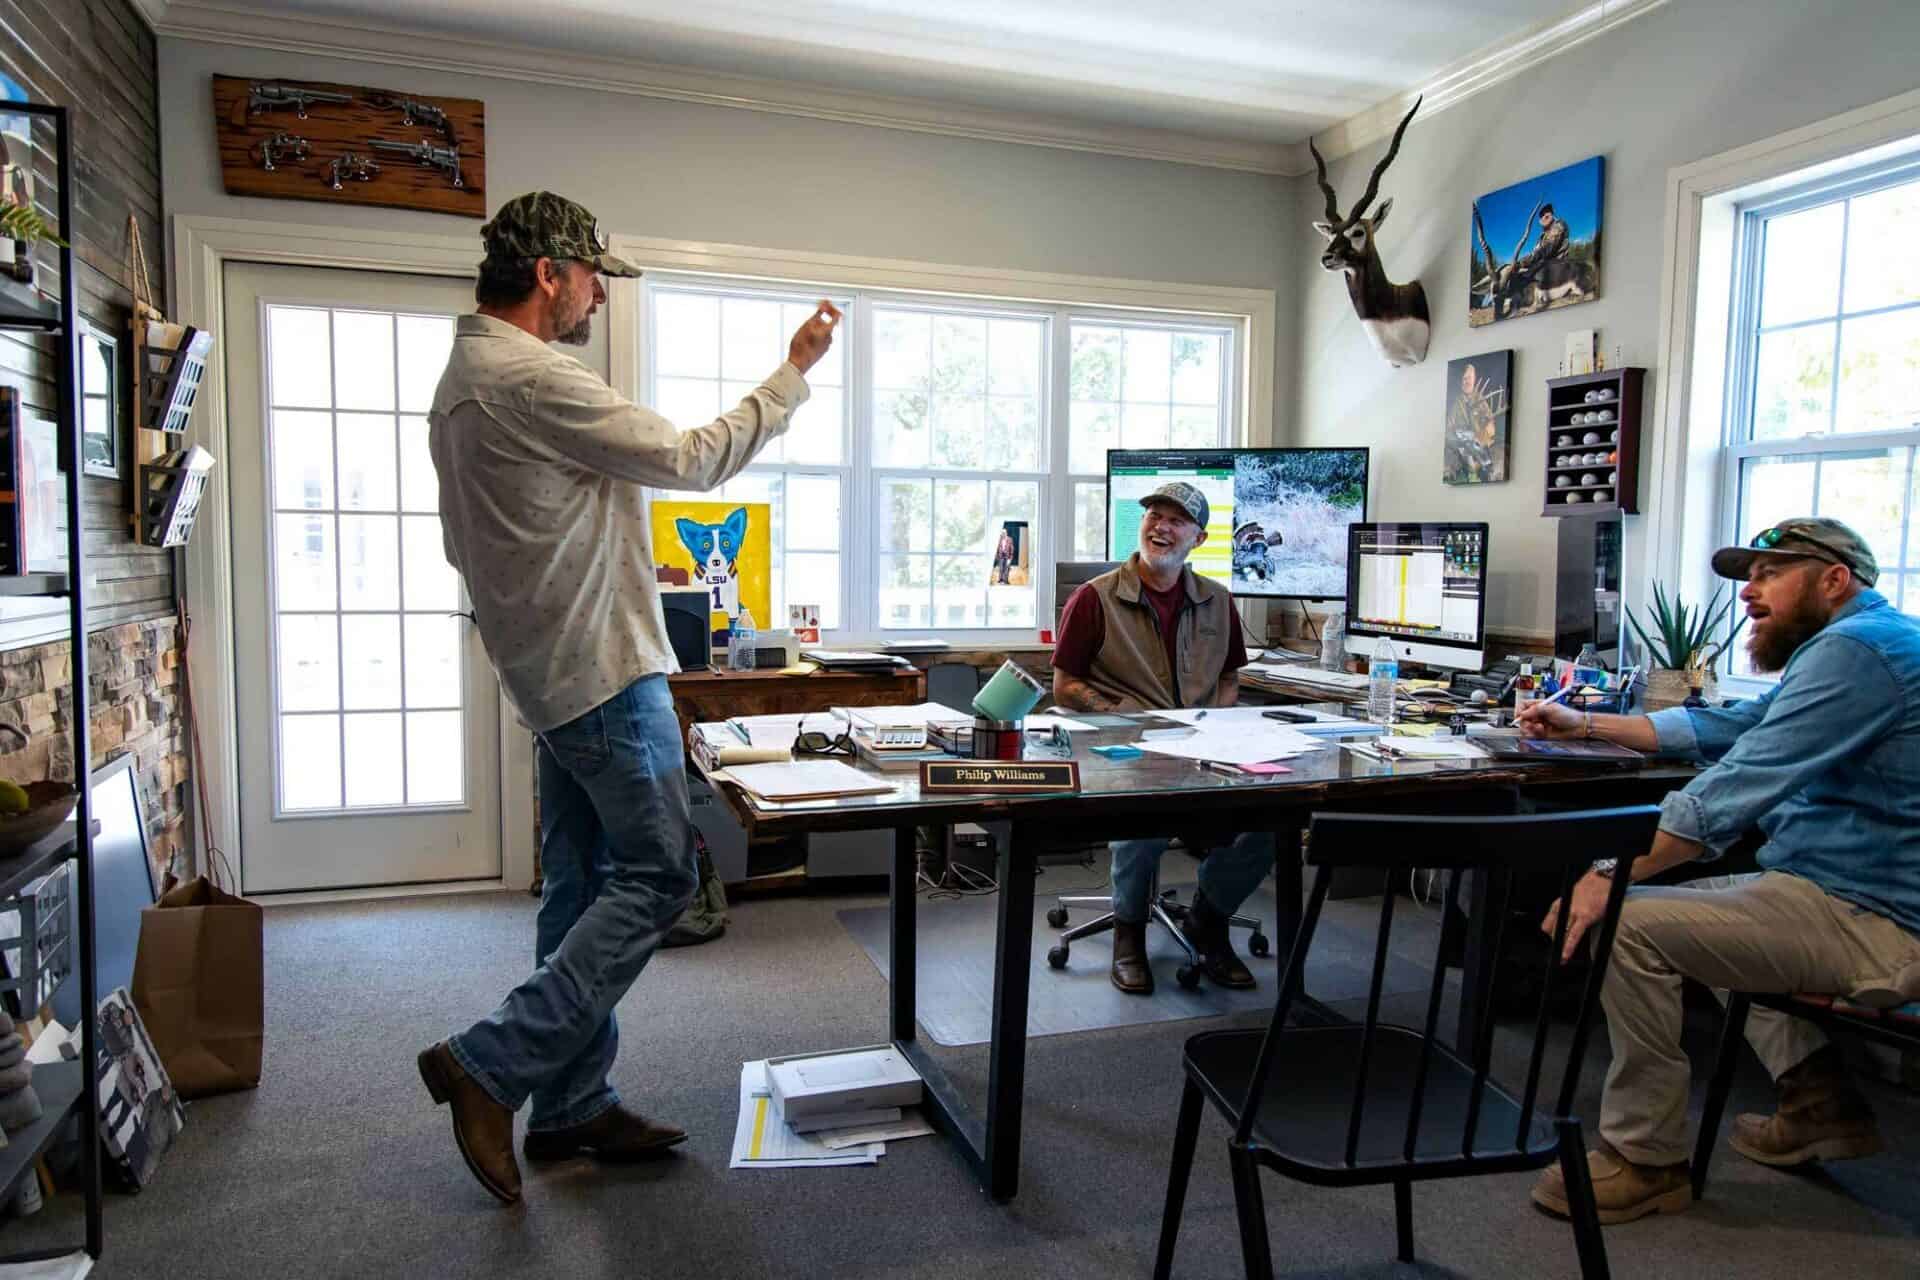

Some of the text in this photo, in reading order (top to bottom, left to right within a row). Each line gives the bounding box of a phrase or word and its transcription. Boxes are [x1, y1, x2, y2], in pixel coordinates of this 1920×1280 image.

[706, 576, 727, 584] LSU
[712, 586, 723, 609] 1
[956, 769, 1046, 782] Philip Williams
